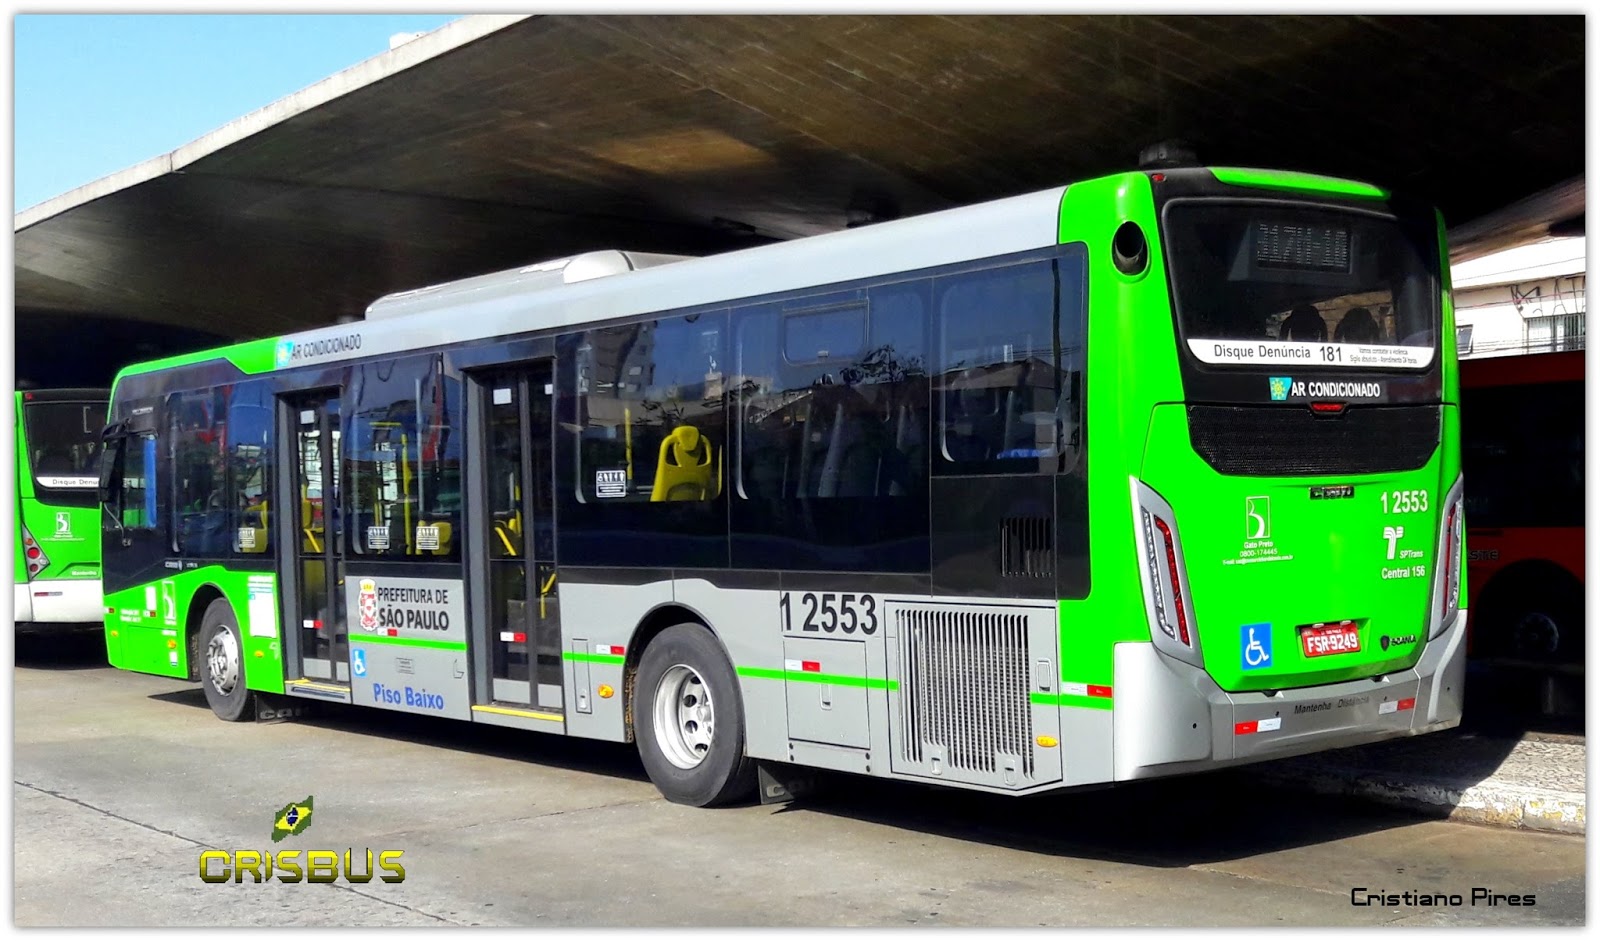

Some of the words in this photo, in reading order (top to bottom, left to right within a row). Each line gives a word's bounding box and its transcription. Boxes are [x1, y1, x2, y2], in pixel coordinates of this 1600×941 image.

[303, 333, 361, 358] CONDICIONADO
[1214, 344, 1254, 360] Disque
[1258, 344, 1311, 359] Denúncia
[1319, 346, 1342, 362] 181
[1291, 382, 1305, 397] AR
[1308, 381, 1381, 398] CONDICIONADO
[1392, 489, 1429, 514] 2553
[1244, 541, 1258, 549] Gato
[1258, 540, 1274, 548] Preto
[1399, 550, 1424, 560] SPTrans
[1381, 566, 1410, 580] Central
[1412, 565, 1426, 577] 156
[378, 587, 433, 603] PREFEITURA
[435, 589, 449, 604] DE
[379, 604, 404, 628] SÃO
[407, 609, 450, 631] PAULO
[802, 592, 878, 635] 2553
[1307, 632, 1358, 653] FSR-9249
[373, 683, 401, 705] Piso
[404, 686, 444, 710] Baixo
[1294, 701, 1332, 714] Mantenha
